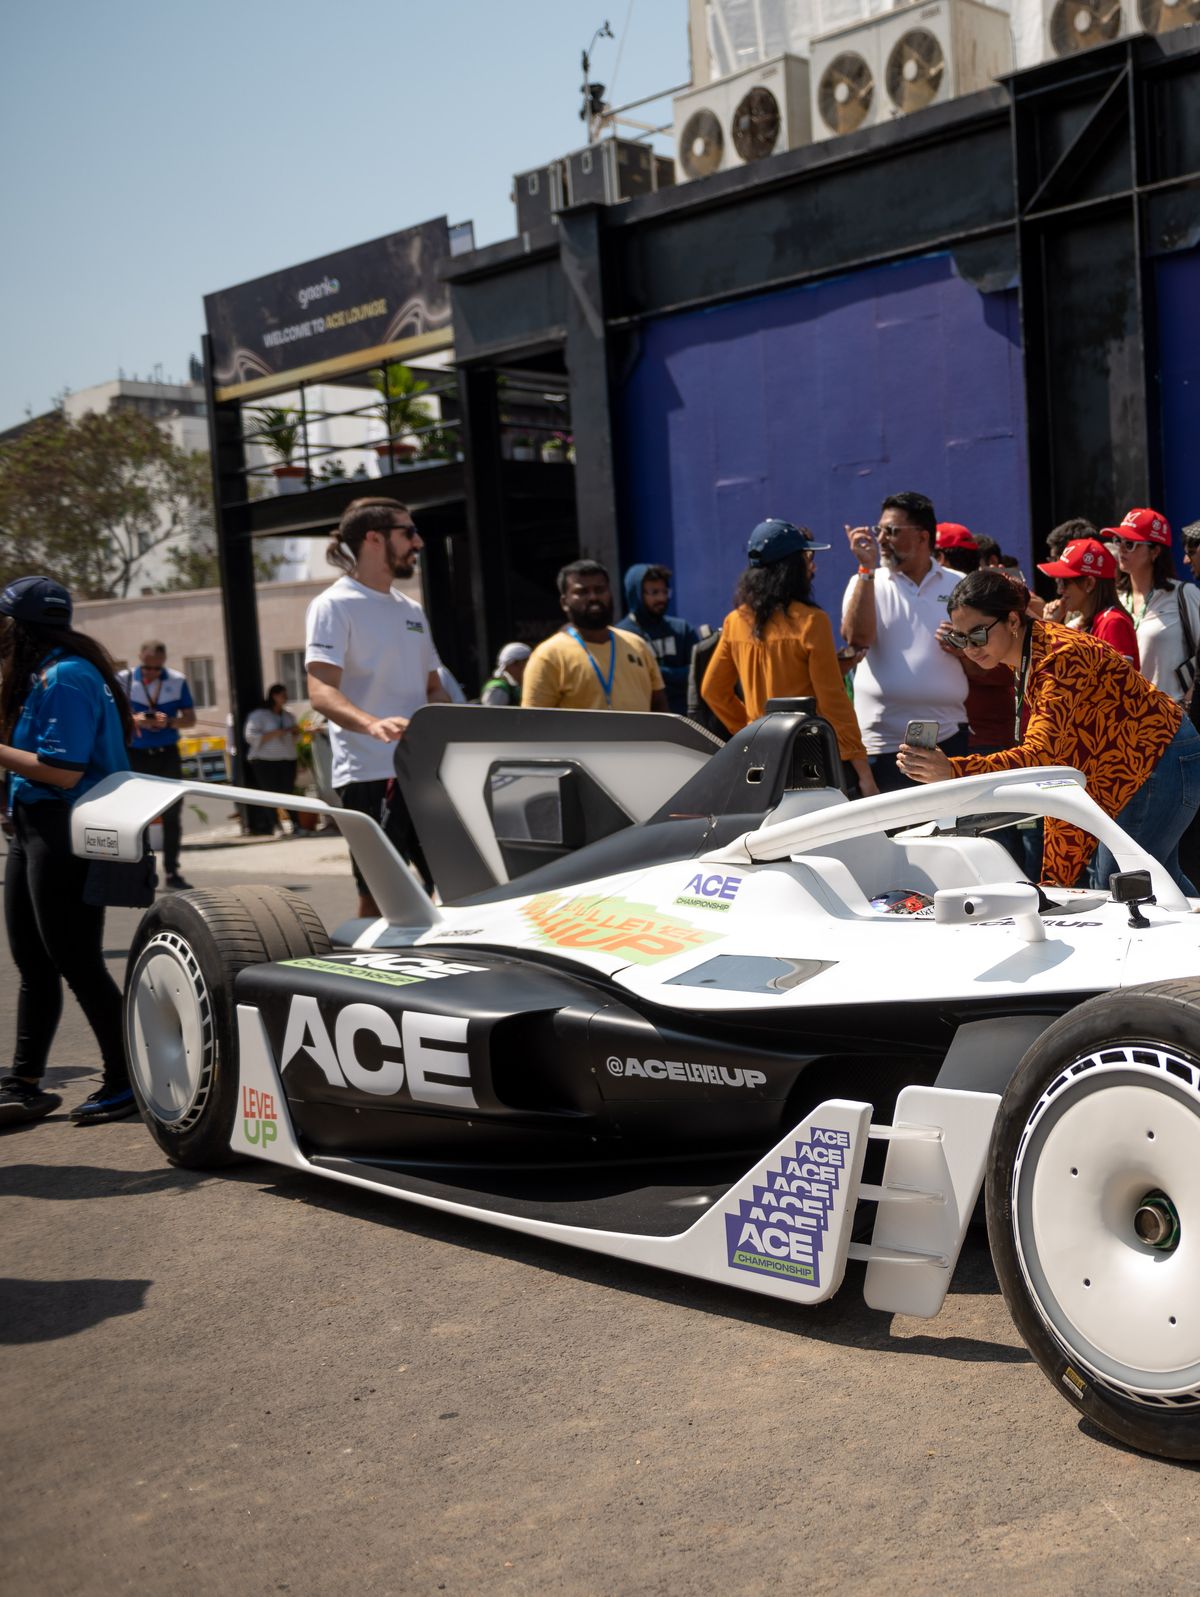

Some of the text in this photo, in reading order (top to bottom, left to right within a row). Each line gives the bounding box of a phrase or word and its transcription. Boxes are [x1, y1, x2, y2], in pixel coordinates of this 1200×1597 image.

[263, 299, 387, 348] WELCOME TO ACE LOUNGE
[682, 874, 742, 900] ACE
[676, 897, 729, 911] CHAMPIONSHIP
[320, 953, 491, 979] ACE
[281, 994, 480, 1109] ACE
[606, 1056, 767, 1089] @ACELEVELUP
[243, 1086, 277, 1120] LEVEL
[243, 1119, 278, 1149] UP
[813, 1129, 848, 1146] ACE
[798, 1144, 842, 1166] ACE
[786, 1160, 836, 1185] ACE
[773, 1176, 830, 1199] ACE
[761, 1191, 823, 1217] ACE
[738, 1222, 814, 1264] ACE
[738, 1253, 812, 1276] CHAMPIONSHIP
